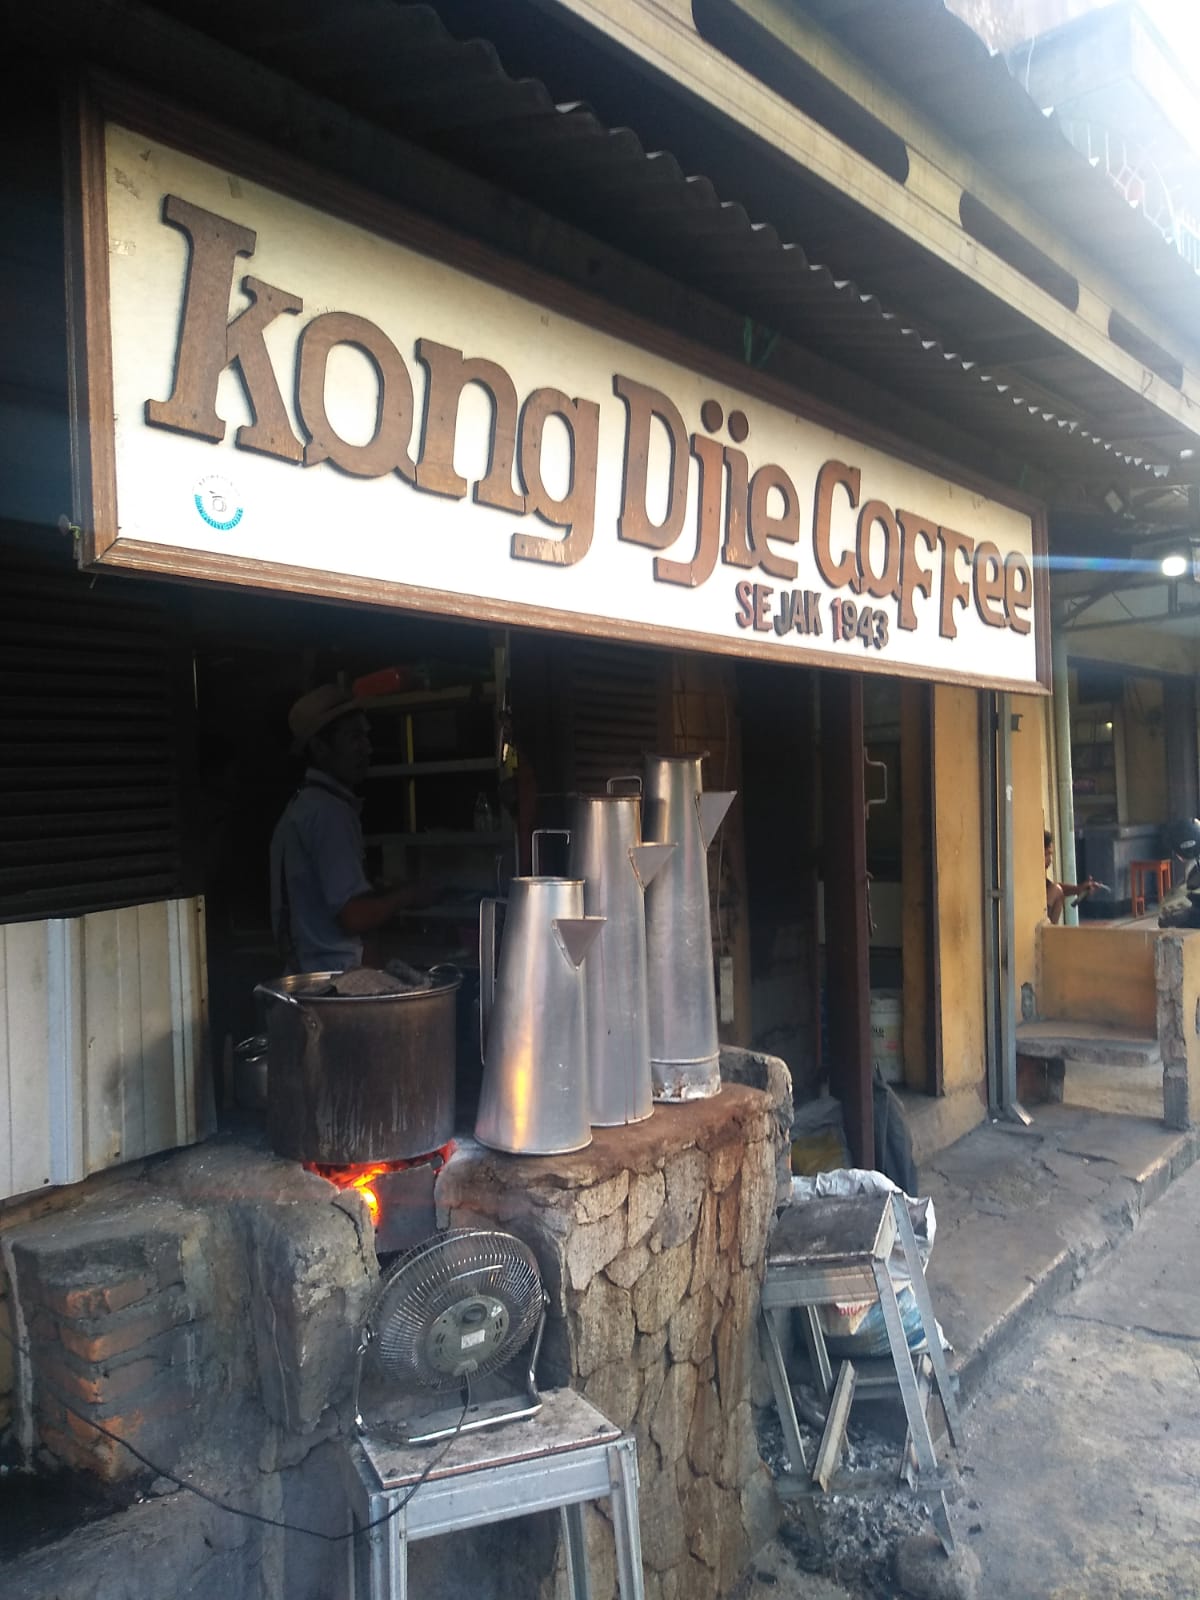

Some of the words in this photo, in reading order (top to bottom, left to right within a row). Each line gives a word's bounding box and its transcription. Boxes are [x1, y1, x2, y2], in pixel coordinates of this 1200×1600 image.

[613, 374, 799, 587] Djie
[735, 581, 823, 636] SEJAK
[830, 597, 889, 649] 1943
